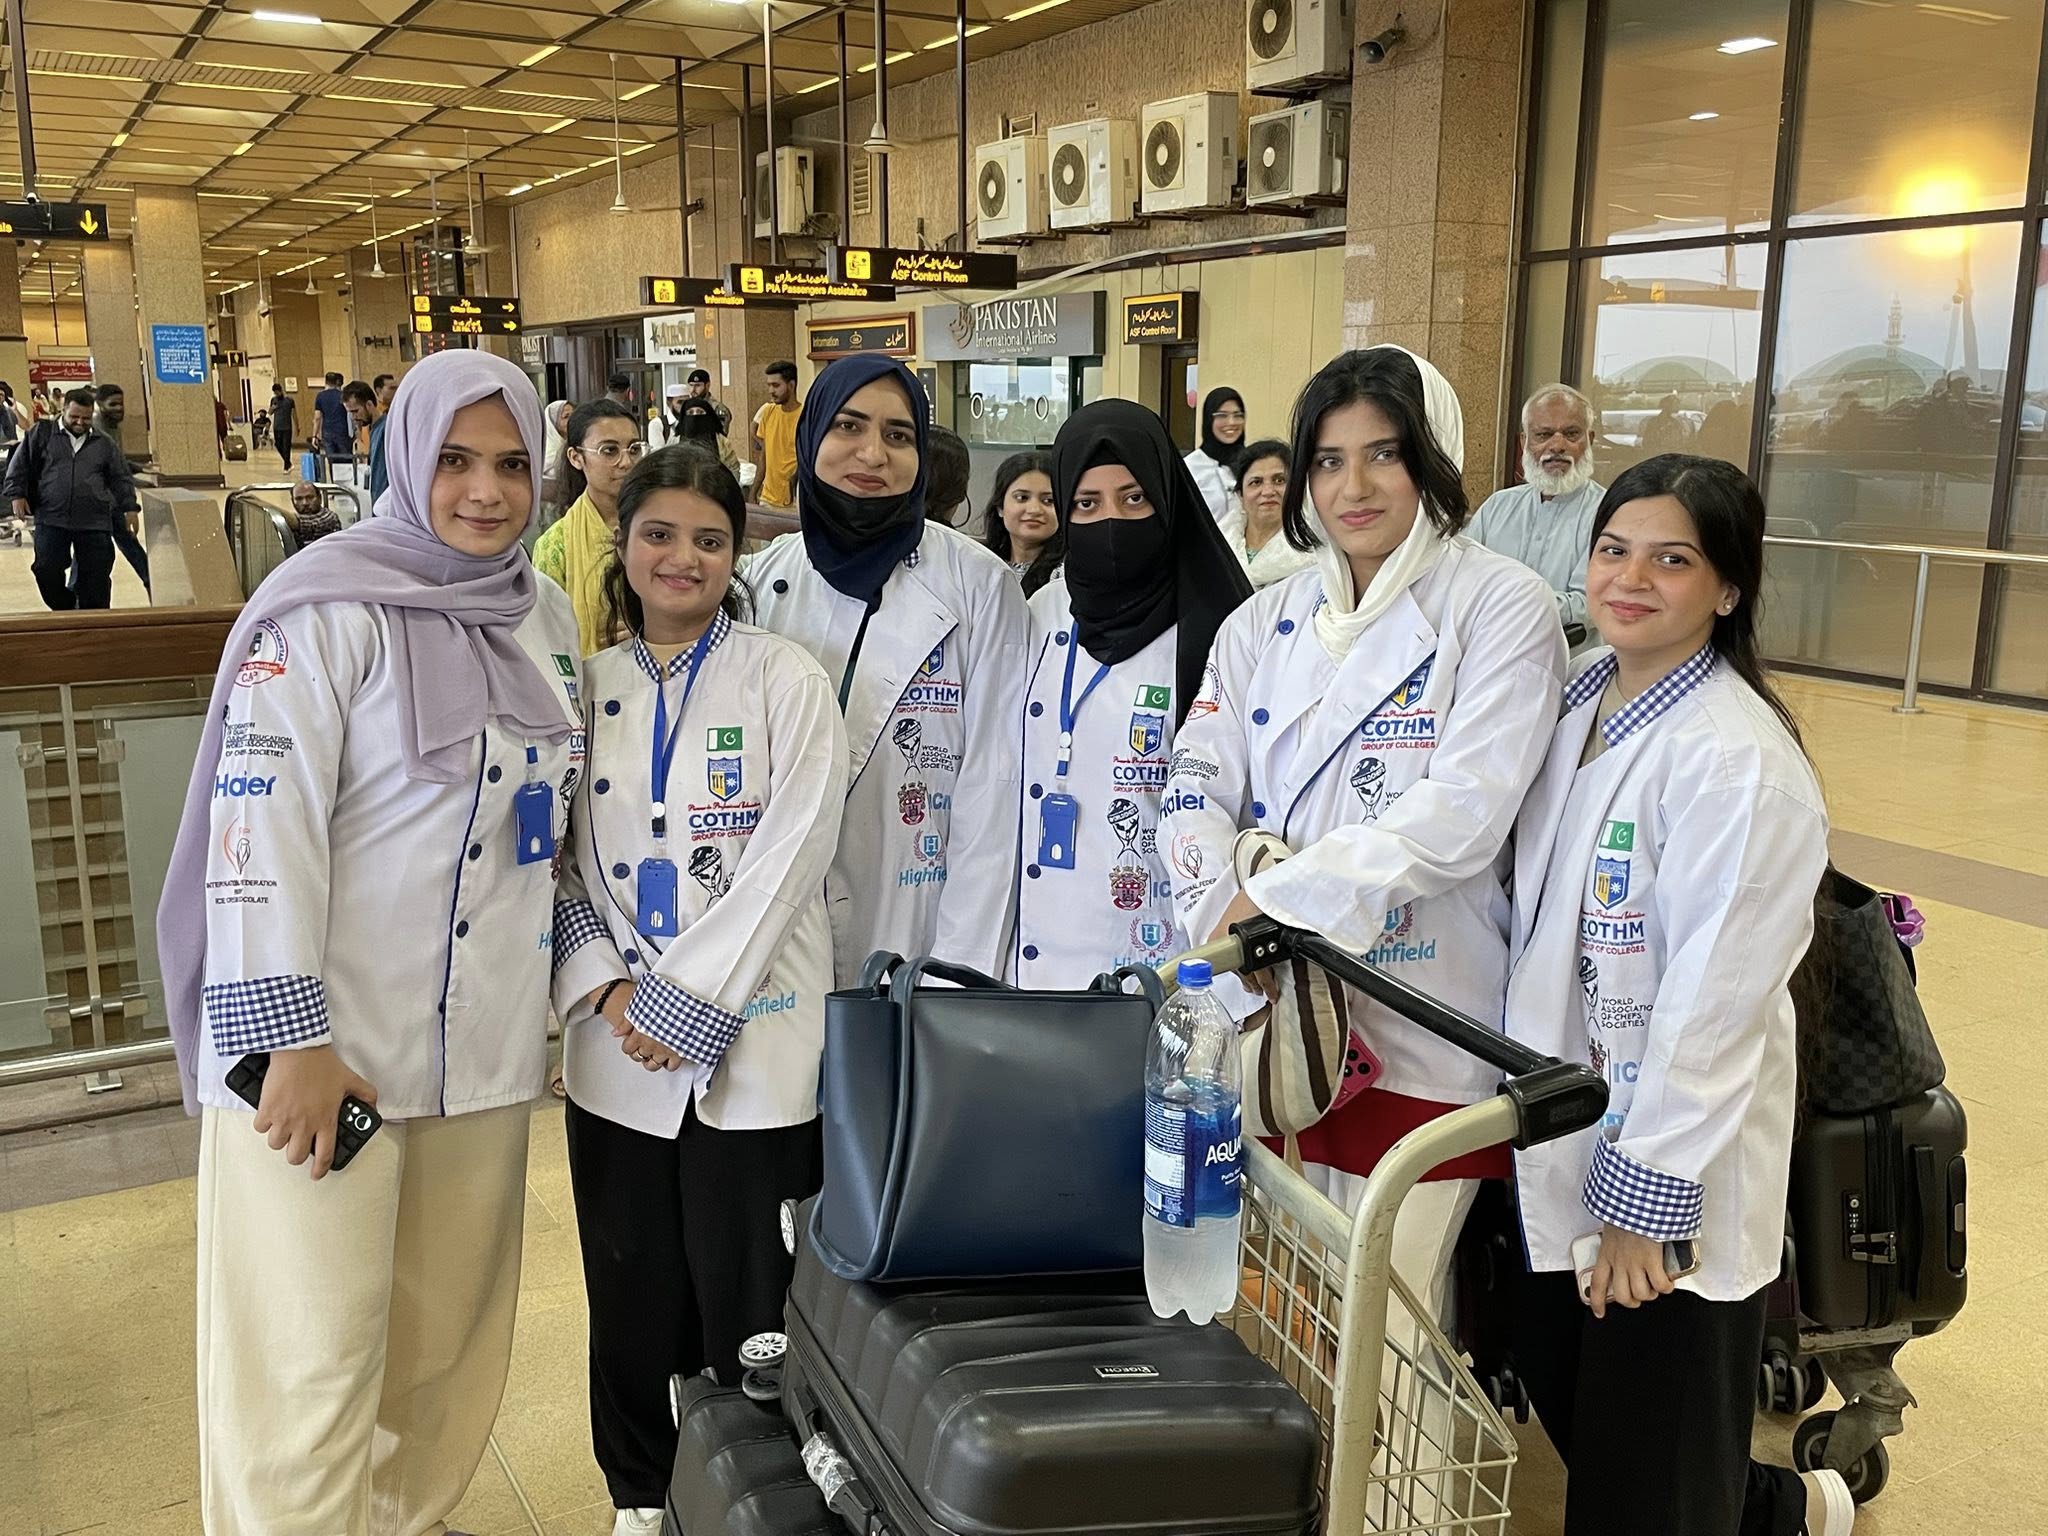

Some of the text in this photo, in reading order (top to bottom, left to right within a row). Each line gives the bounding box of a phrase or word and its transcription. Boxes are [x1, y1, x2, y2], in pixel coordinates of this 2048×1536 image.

[891, 269, 968, 283] ASF Control Room
[766, 282, 868, 297] PIA Passengers Assistance
[704, 294, 745, 305] Information
[975, 297, 1057, 331] PAKISTAN
[1130, 325, 1176, 337] ASF Control Room
[976, 329, 1057, 348] International Airlines
[929, 706, 958, 714] COLLEGES
[1361, 717, 1435, 736] COTHM
[249, 734, 293, 744] EDUCATION
[922, 745, 949, 753] WORLD
[1361, 743, 1385, 751] GROUP
[1395, 741, 1436, 749] COLLEGES
[248, 748, 285, 758] SOCIETIES
[921, 752, 962, 761] ASSOCIATIO
[920, 763, 954, 772] SOCIETIES
[214, 770, 277, 798] Haier
[689, 809, 759, 829] COTHM
[692, 831, 716, 841] GROUP
[727, 829, 754, 838] COLLEG
[898, 866, 948, 888] Highfie
[1153, 881, 1171, 898] IC
[1581, 918, 1644, 940] COTHM
[1365, 939, 1436, 965] ghfield
[1595, 945, 1605, 953] OF
[1606, 944, 1645, 955] COLLEGES
[743, 991, 796, 1022] ghfield
[1601, 997, 1634, 1006] WORLD
[1601, 1004, 1654, 1014] ASSOCIATIO
[1601, 1012, 1642, 1020] OF CHEFS
[1601, 1020, 1645, 1029] SOCIETIES
[1614, 1061, 1641, 1083] IC
[1205, 1135, 1241, 1167] AQUA
